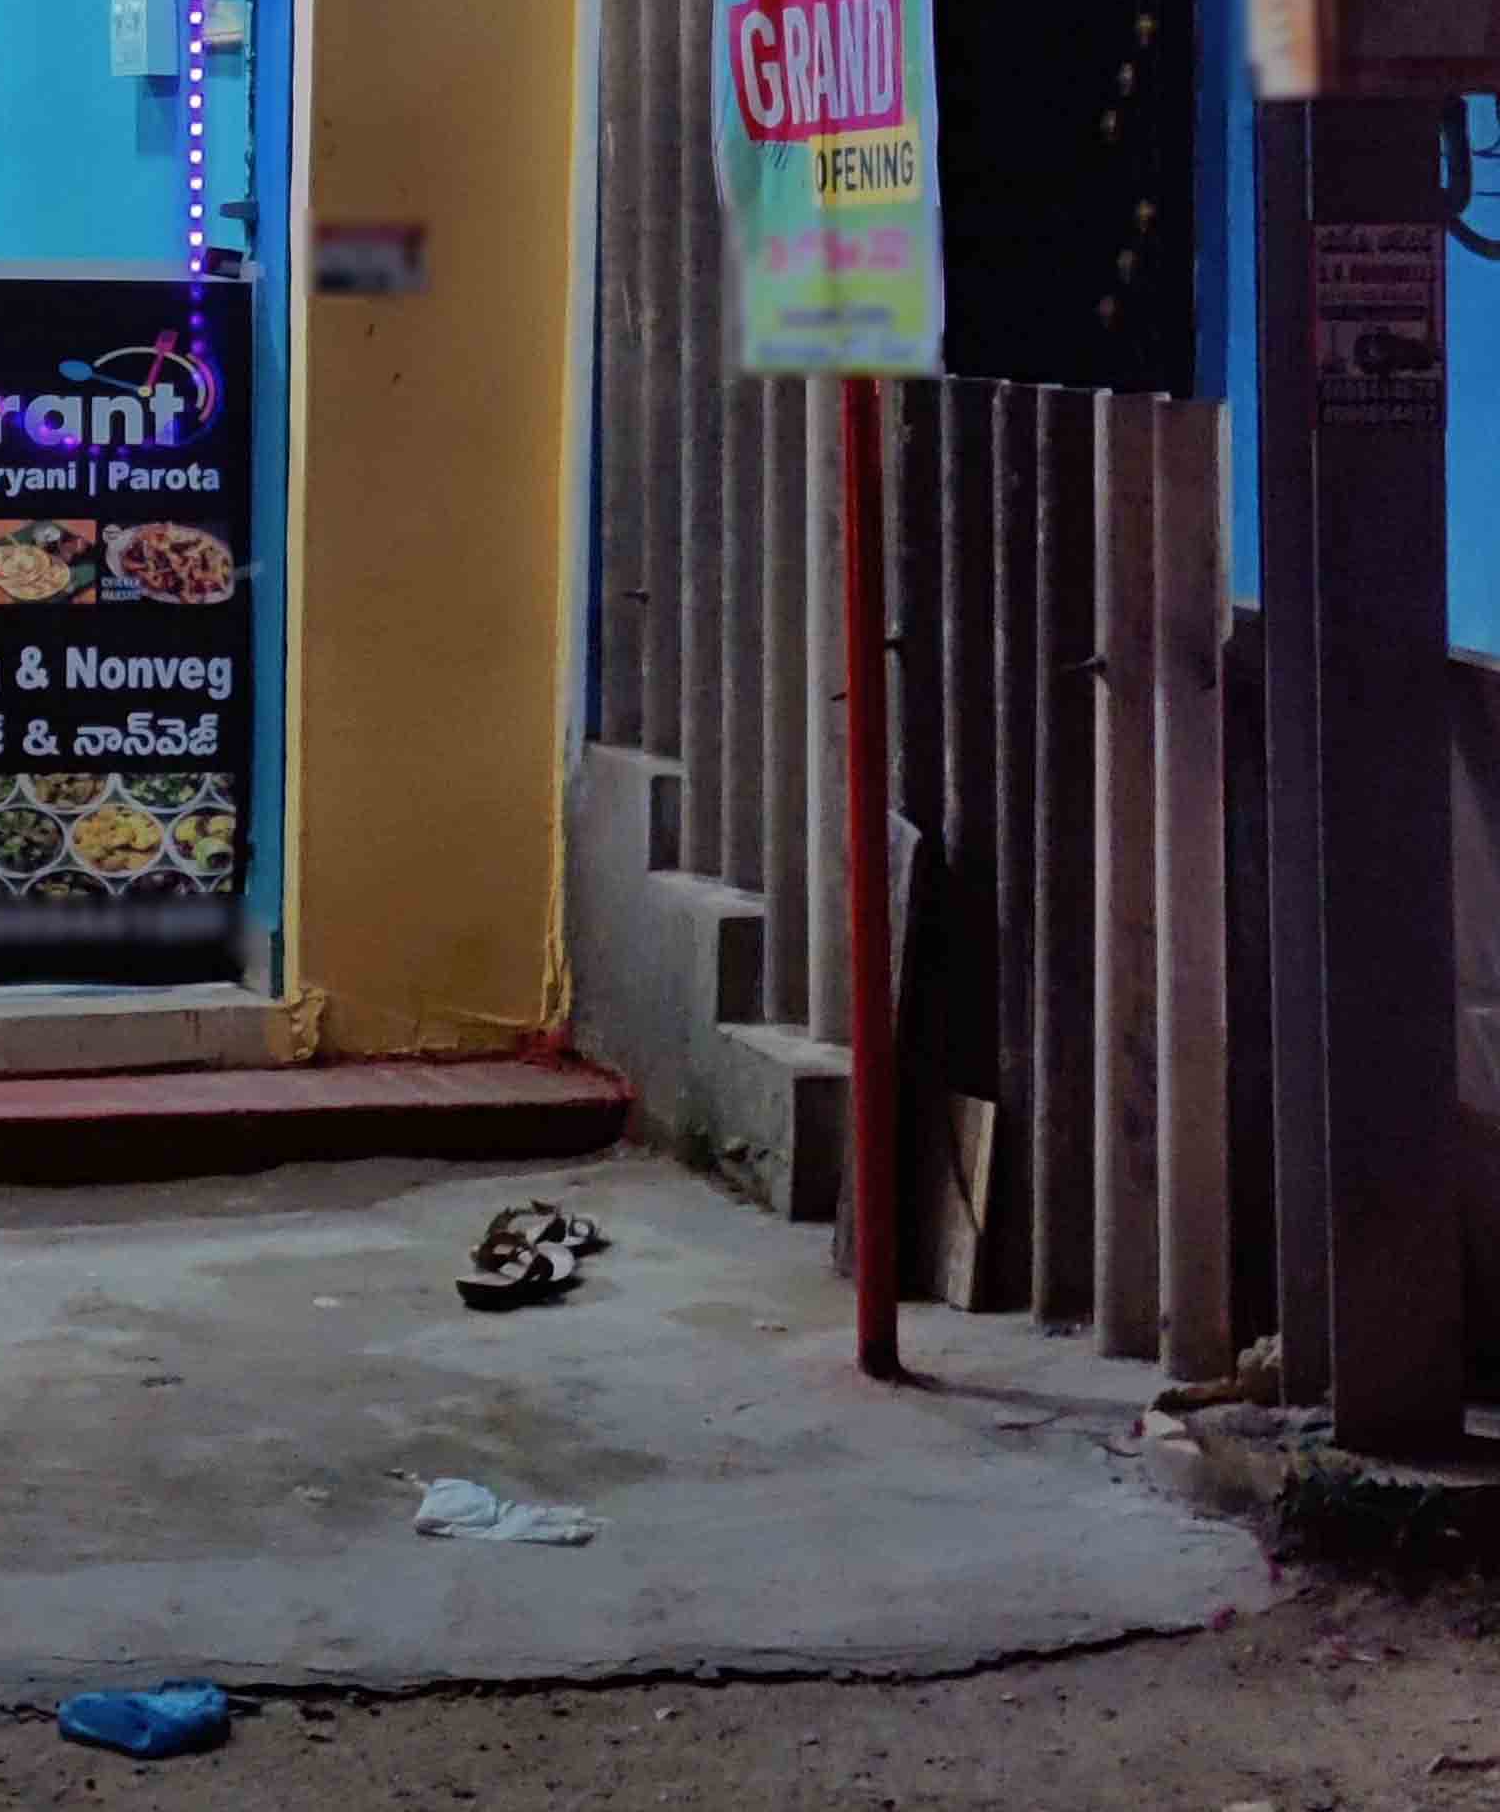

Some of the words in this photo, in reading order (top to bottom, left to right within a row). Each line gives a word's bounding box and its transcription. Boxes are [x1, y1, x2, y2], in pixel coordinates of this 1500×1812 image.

[107, 460, 221, 491] Parota
[14, 645, 49, 690] &
[64, 646, 233, 701] Nonveg
[22, 719, 61, 756] &
